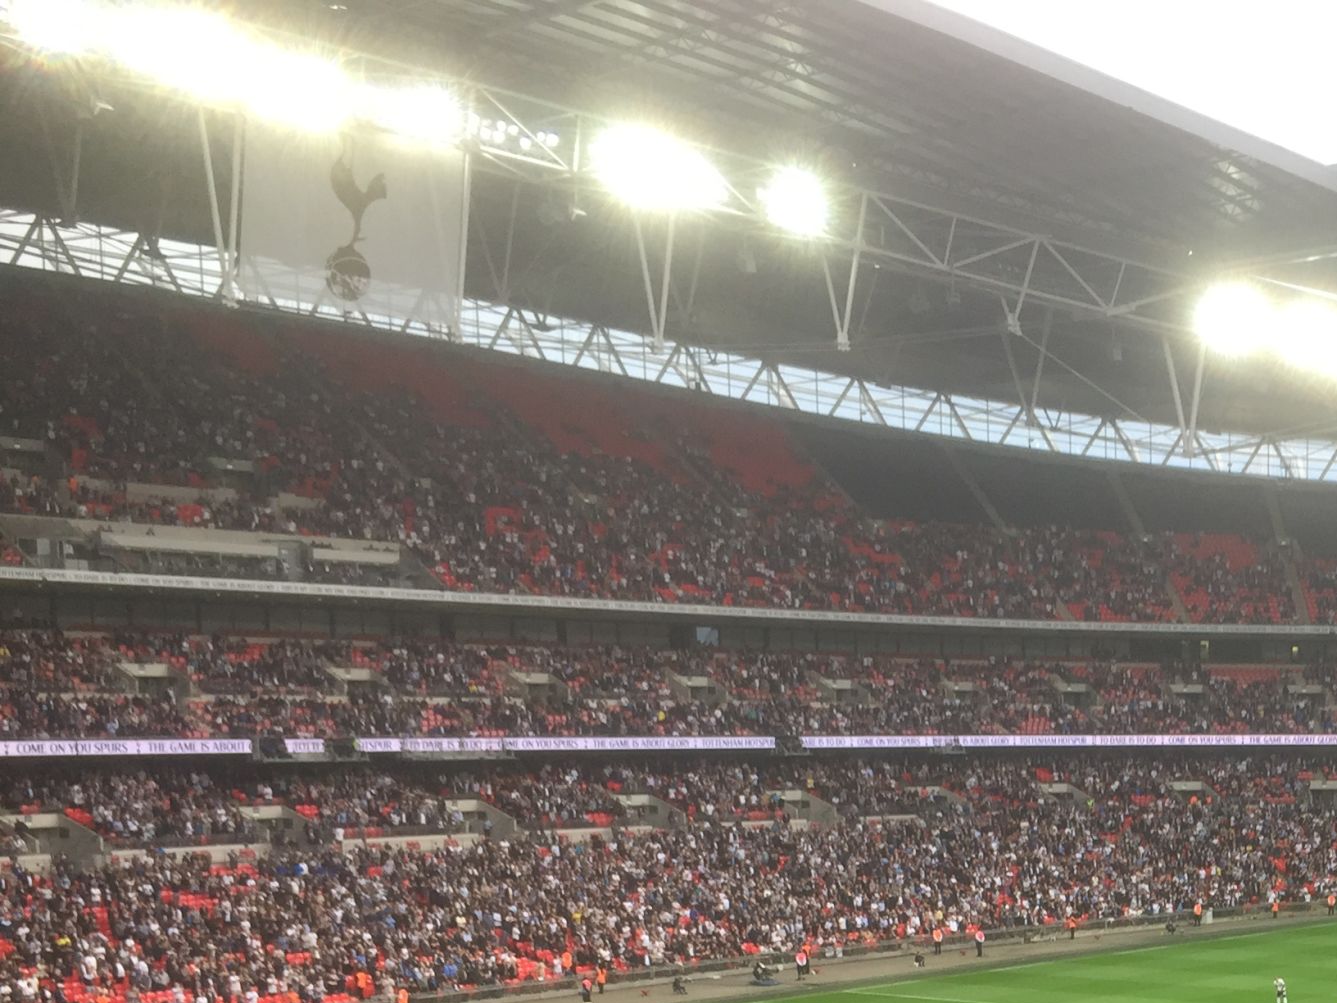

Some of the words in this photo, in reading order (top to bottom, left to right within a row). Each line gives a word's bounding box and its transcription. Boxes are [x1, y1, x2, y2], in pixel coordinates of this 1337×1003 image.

[16, 743, 45, 754] COME
[94, 742, 128, 753] SPURS
[170, 741, 197, 752] GAME
[212, 741, 245, 751] ABOUT
[553, 739, 578, 748] SPURS
